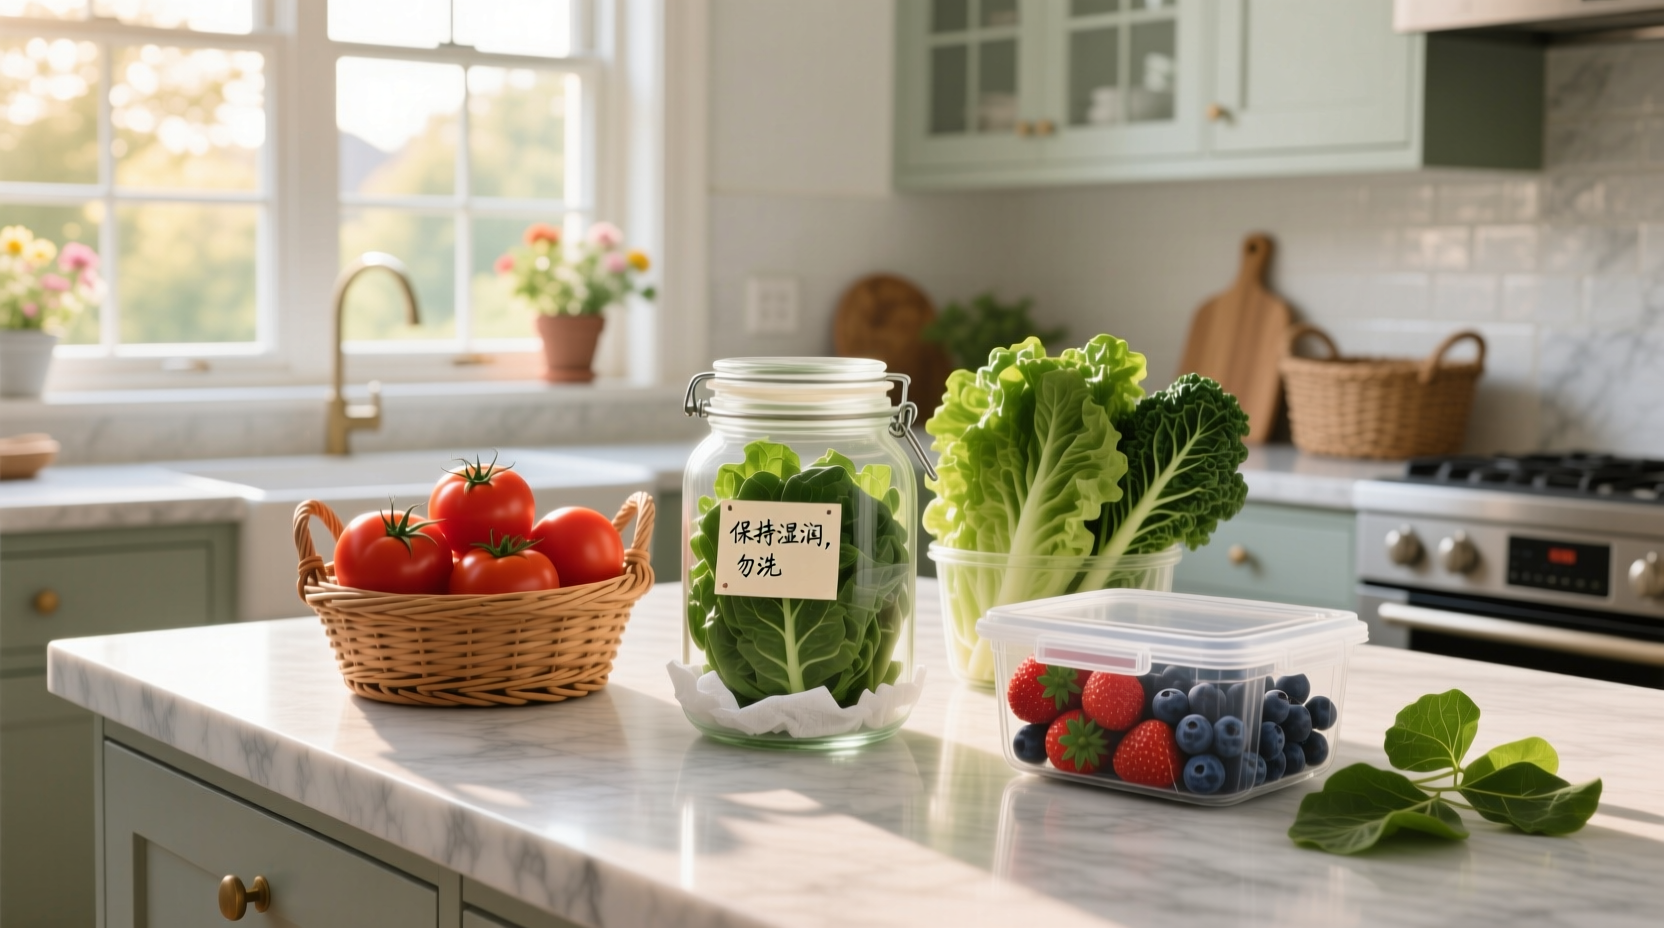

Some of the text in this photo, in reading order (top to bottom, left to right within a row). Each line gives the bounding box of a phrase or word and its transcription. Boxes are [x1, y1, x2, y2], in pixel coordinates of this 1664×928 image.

[729, 518, 831, 550] 保持湿润，
[736, 552, 782, 578] 勿洗
